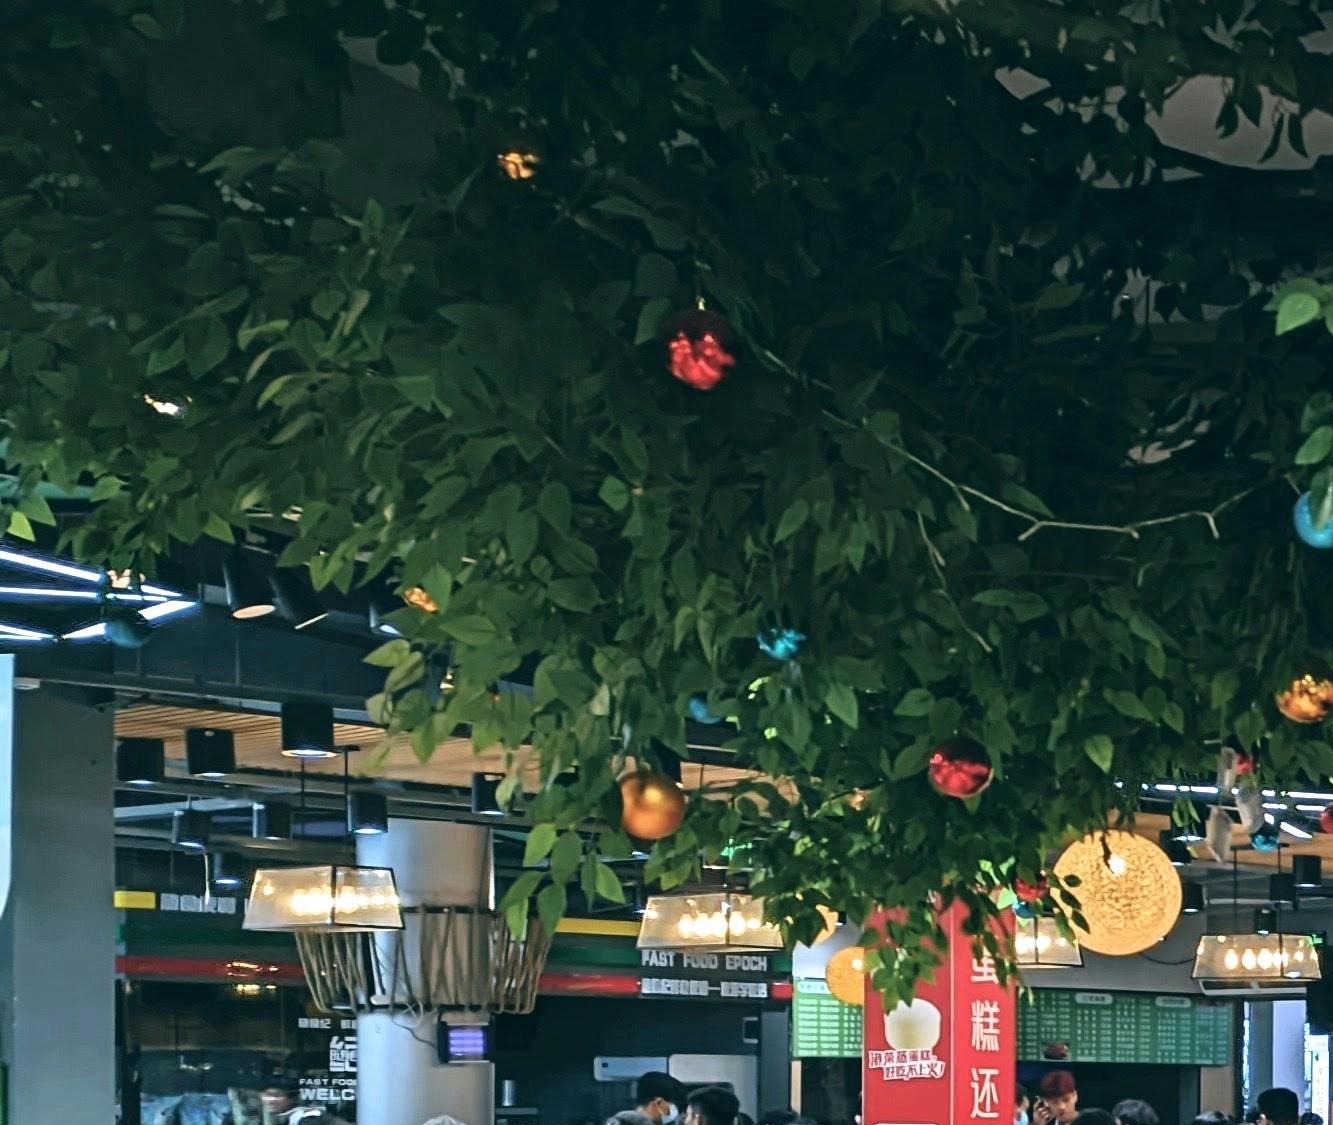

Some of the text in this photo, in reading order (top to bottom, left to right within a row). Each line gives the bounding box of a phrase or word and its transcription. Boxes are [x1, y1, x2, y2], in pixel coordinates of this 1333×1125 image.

[642, 950, 768, 971] FAST FOOD EPOCH
[299, 1078, 329, 1086] FAST
